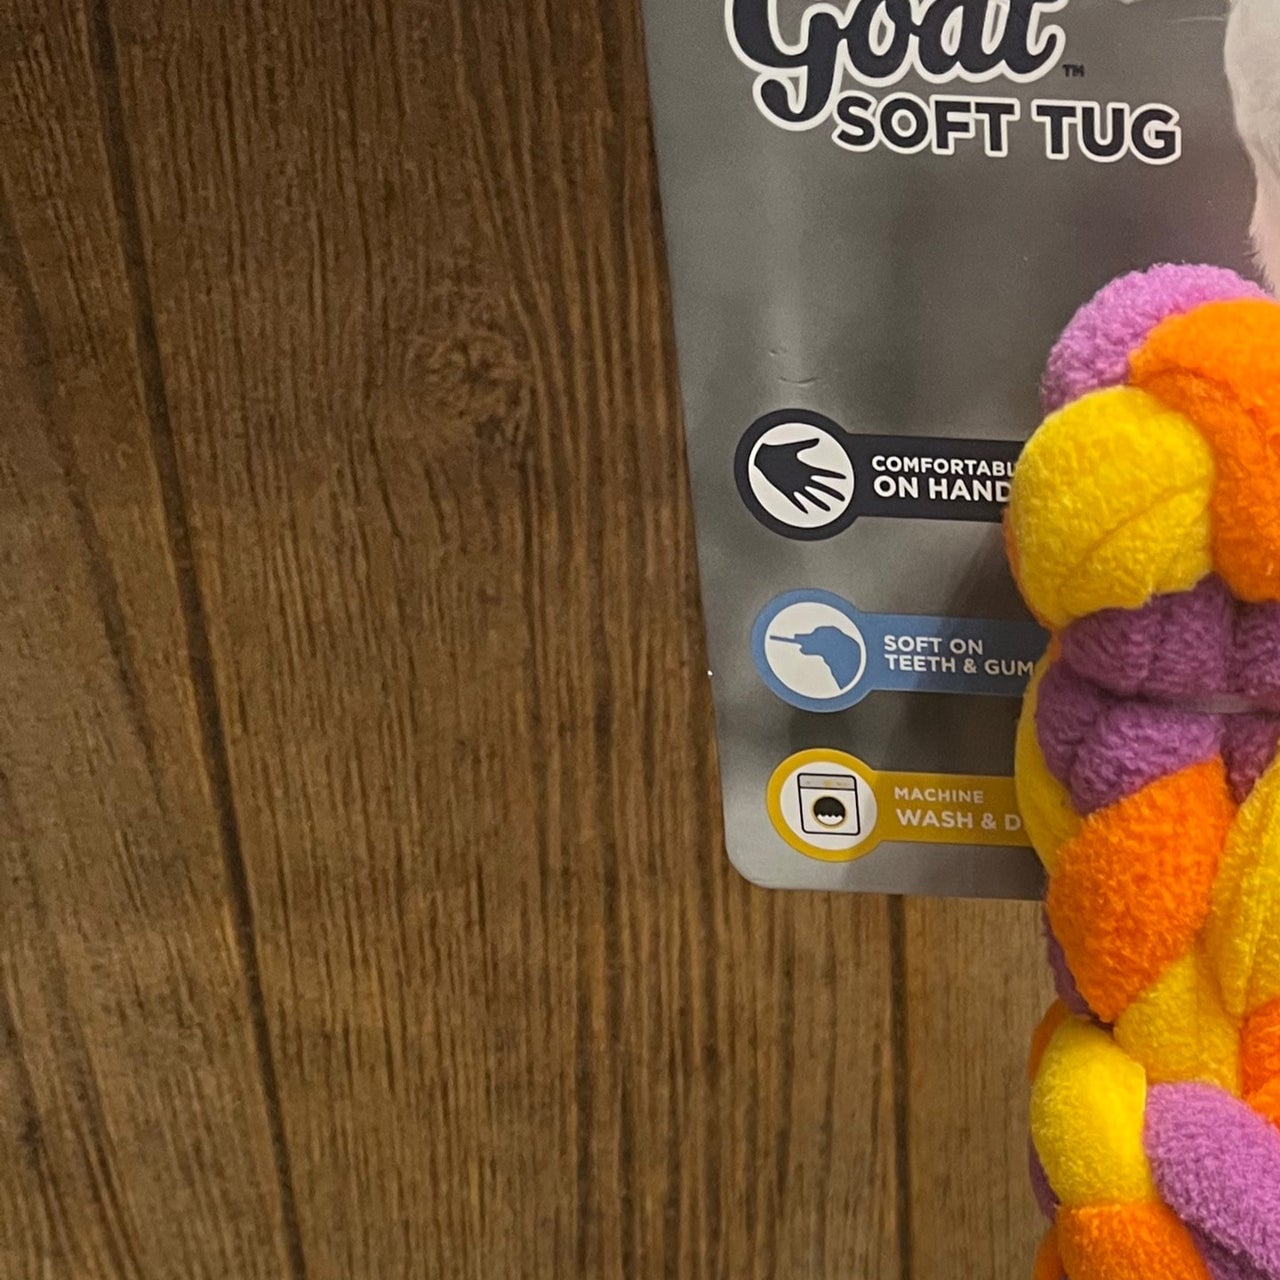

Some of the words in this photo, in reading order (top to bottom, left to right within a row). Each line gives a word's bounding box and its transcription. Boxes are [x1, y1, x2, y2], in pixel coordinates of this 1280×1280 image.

[834, 92, 1018, 155] SOFT
[1033, 100, 1180, 163] TUG
[873, 474, 920, 499] ON
[883, 634, 943, 653] SOFT
[949, 638, 984, 655] ON
[884, 654, 957, 673] TEETH
[963, 657, 978, 674] &
[894, 786, 985, 804] MACHINE
[896, 808, 974, 829] WASH
[980, 812, 997, 830] &
